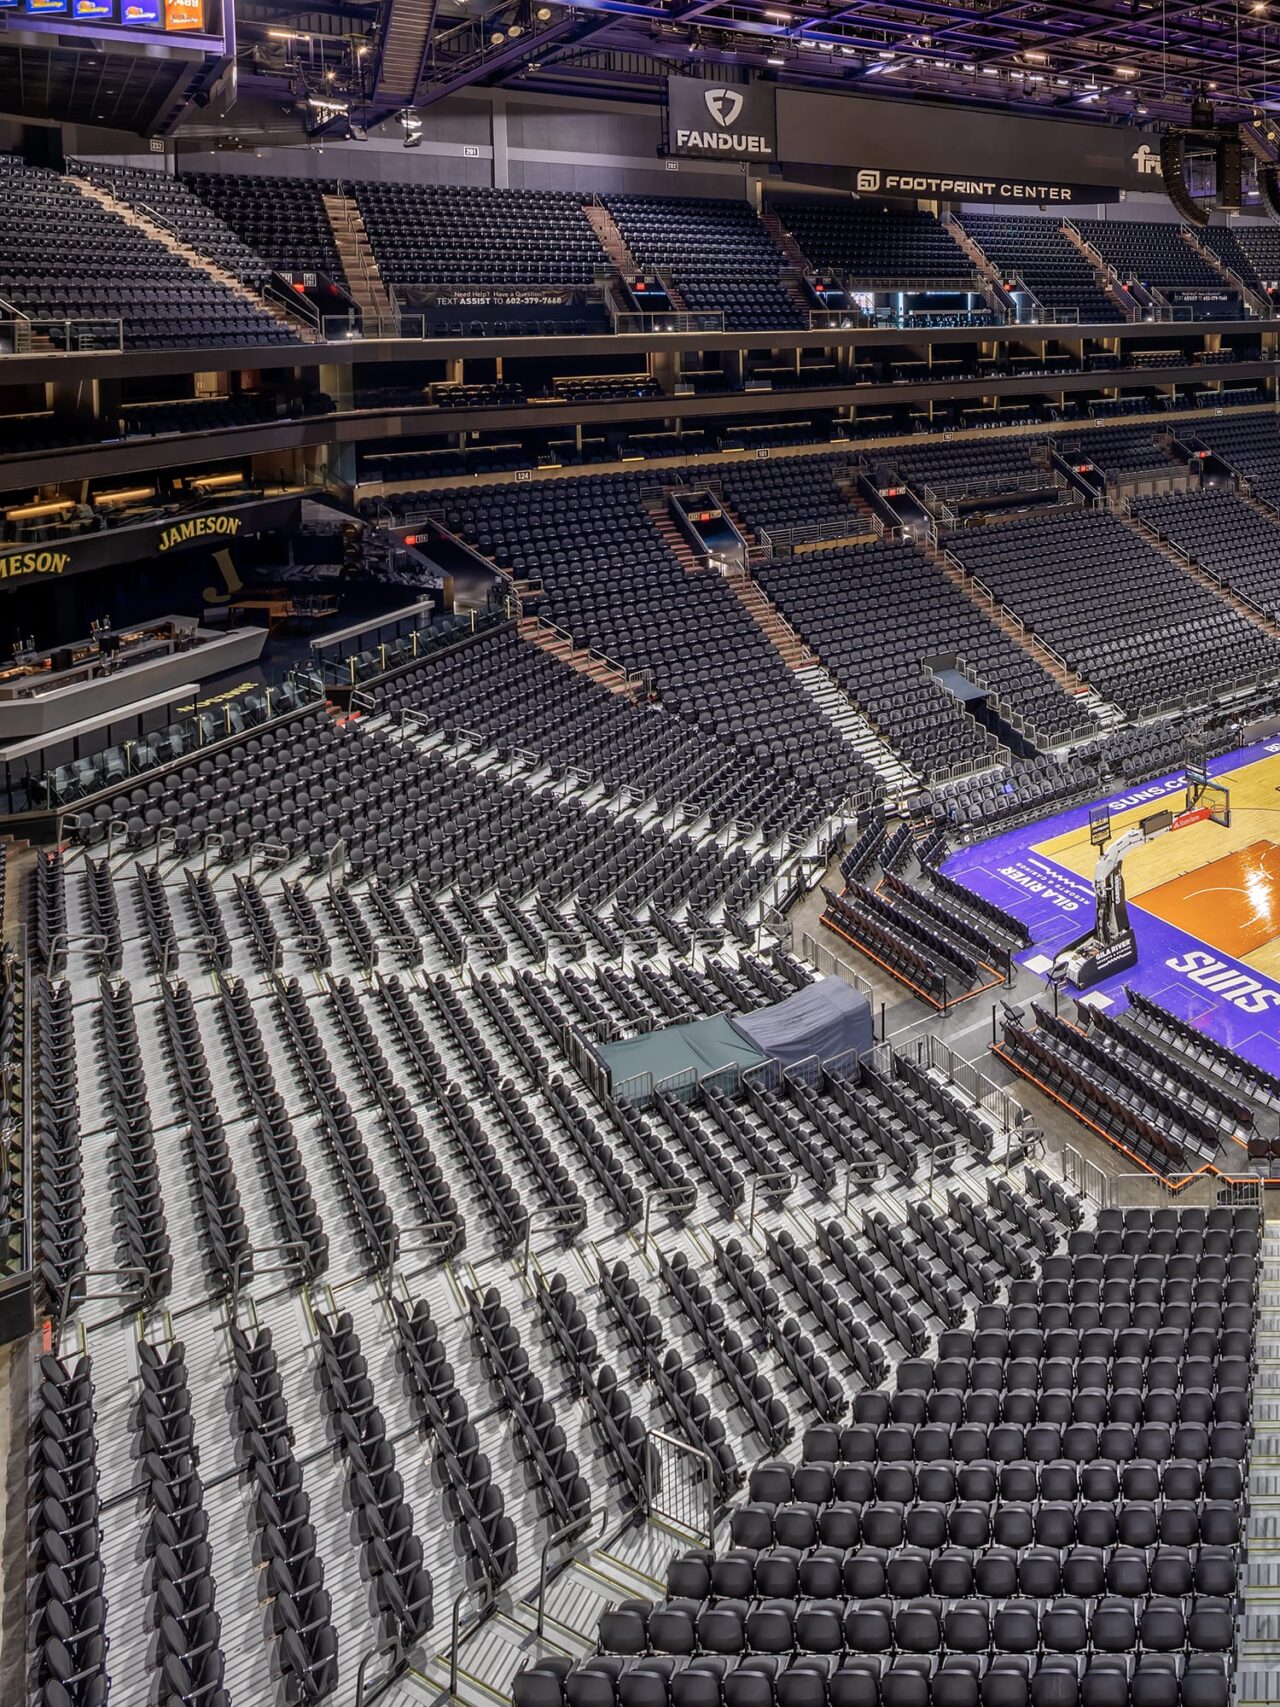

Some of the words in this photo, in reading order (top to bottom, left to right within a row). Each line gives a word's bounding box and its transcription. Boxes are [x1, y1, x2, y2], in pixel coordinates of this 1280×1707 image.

[676, 130, 772, 153] FANDUEL
[886, 177, 996, 195] FOOTPRINT
[1000, 184, 1071, 200] CENTER
[437, 297, 458, 305] TEXT
[459, 297, 491, 305] ASSIST
[505, 296, 562, 304] 602-379-7668
[159, 516, 241, 550] JAMESON
[202, 548, 243, 604] J
[1109, 772, 1212, 811] SUNS.CO
[999, 866, 1047, 893] RIVER
[1041, 889, 1079, 911] GILA
[1095, 947, 1111, 961] GILA
[1111, 938, 1131, 953] RIVER
